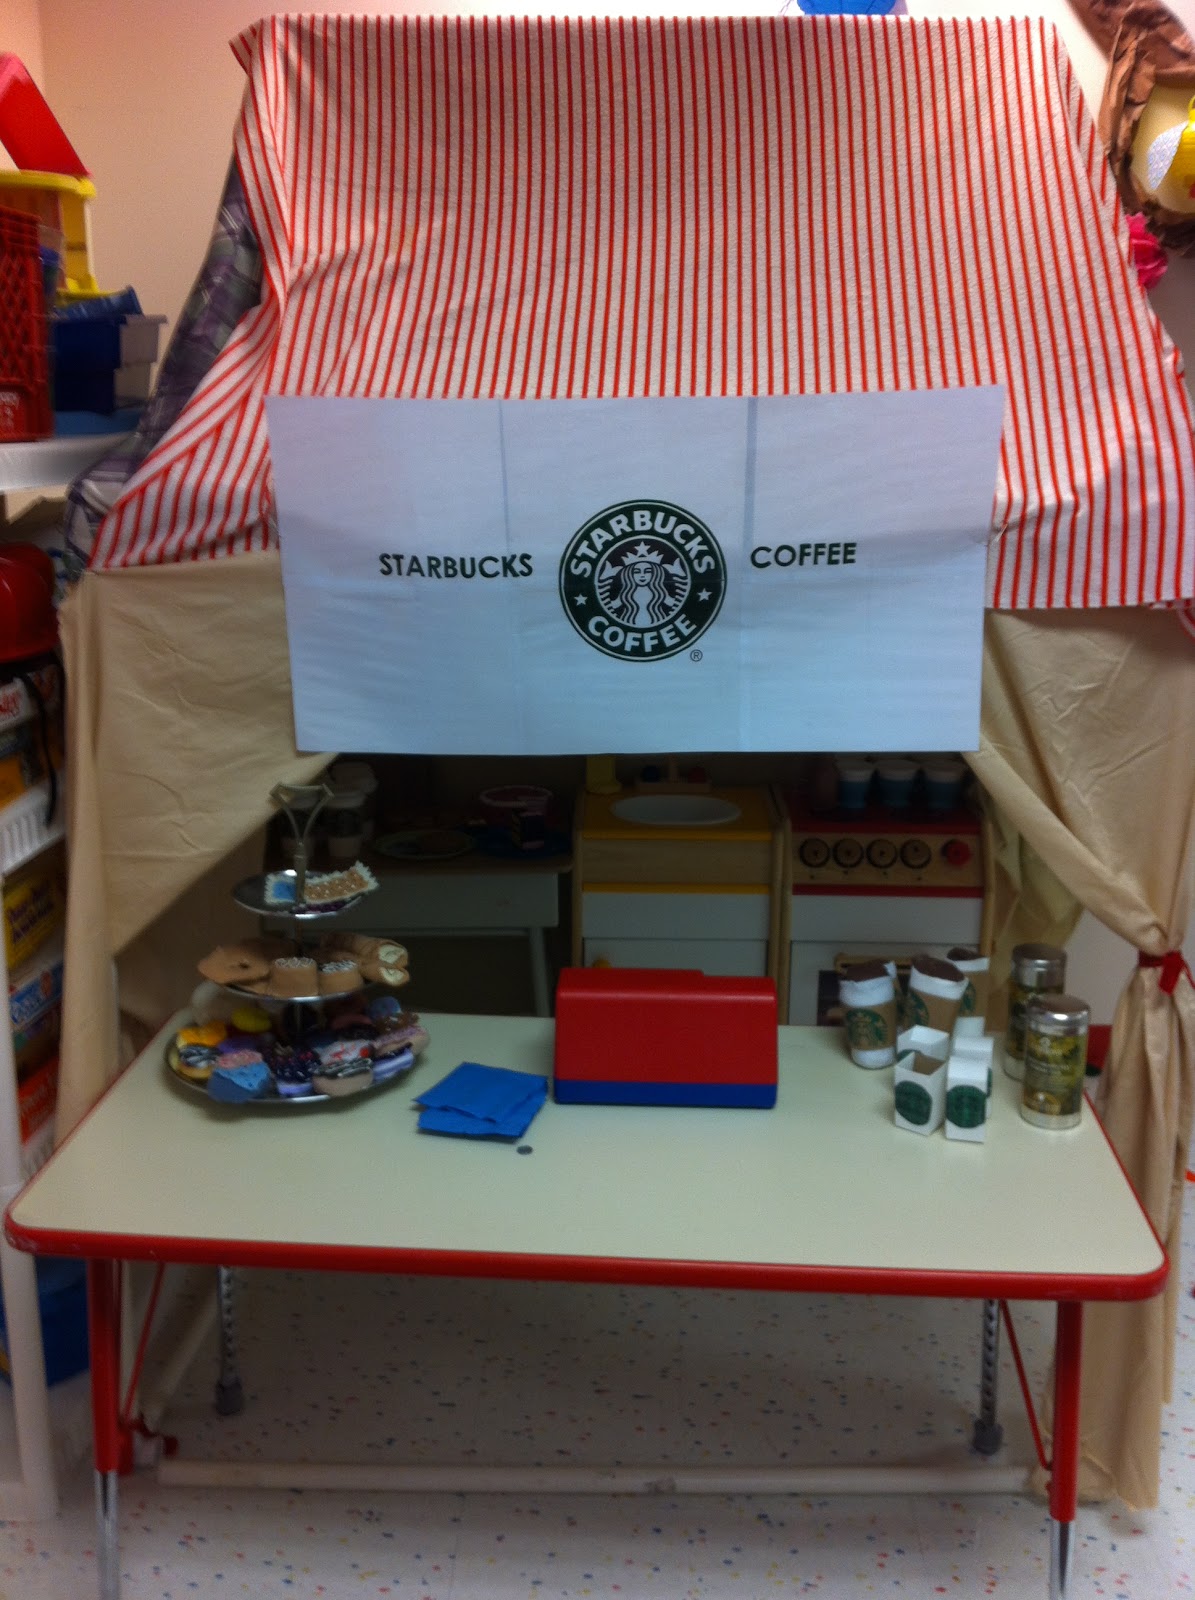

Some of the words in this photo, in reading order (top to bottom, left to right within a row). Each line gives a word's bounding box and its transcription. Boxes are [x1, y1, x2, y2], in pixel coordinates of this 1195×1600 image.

[379, 552, 534, 580] STARBUCKS
[750, 541, 857, 569] COFFEE
[570, 510, 717, 580] STARBUCKS
[587, 613, 698, 654] COFFEE
